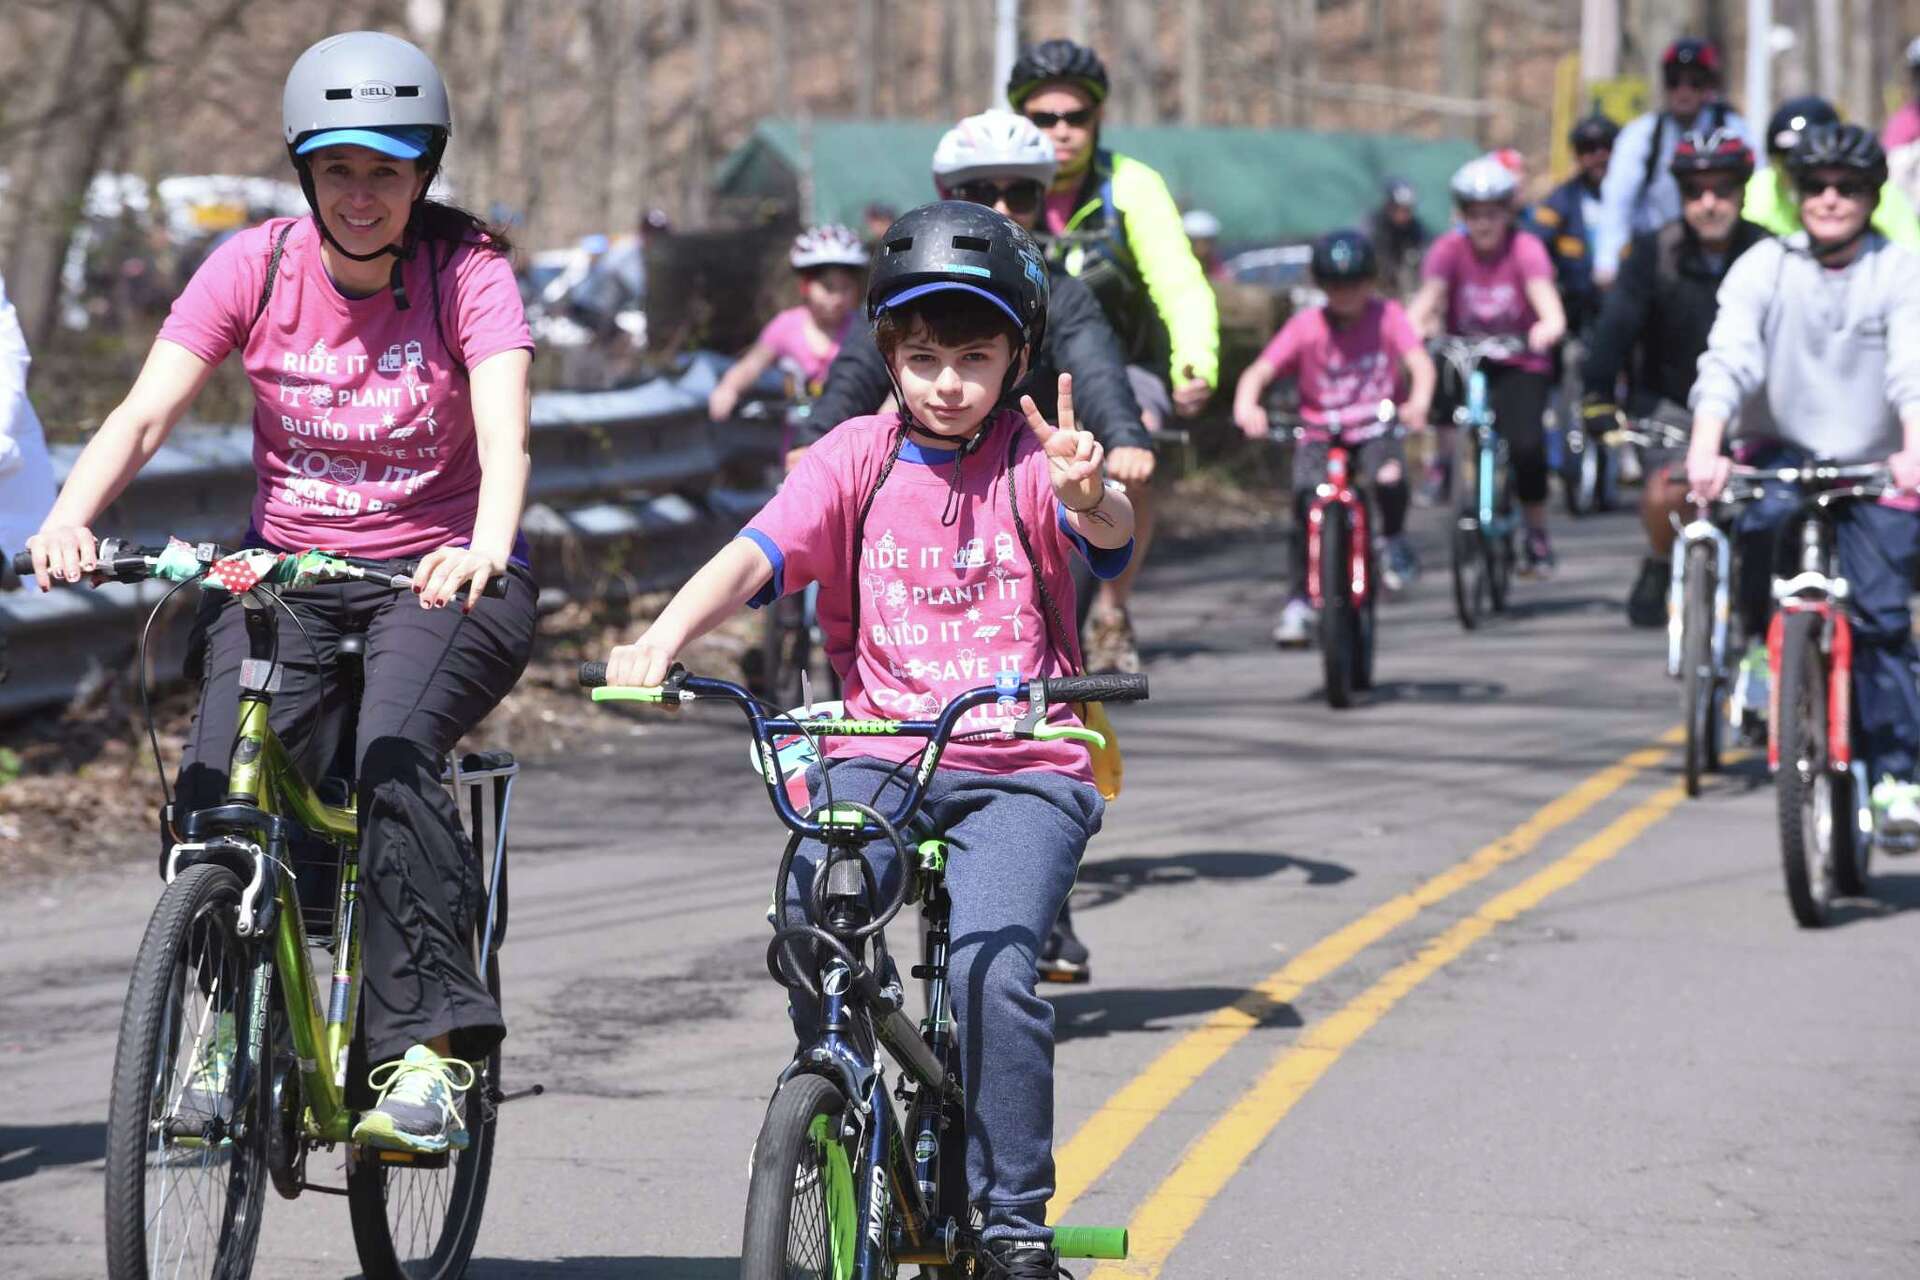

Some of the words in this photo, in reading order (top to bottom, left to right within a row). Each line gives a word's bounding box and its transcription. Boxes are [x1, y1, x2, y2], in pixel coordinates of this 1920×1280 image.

[360, 87, 392, 97] BELL
[283, 352, 338, 375] RIDE
[347, 354, 368, 375] IT
[338, 387, 402, 408] PLANT
[407, 384, 430, 407] IT
[281, 415, 348, 442] BUILD
[359, 423, 379, 441] IT
[417, 446, 438, 460] IT
[336, 487, 362, 516] TO
[920, 547, 944, 568] IT
[912, 581, 987, 606] PLANT
[998, 578, 1020, 600] IT
[872, 623, 929, 646] BUILD
[940, 621, 963, 643] IT
[929, 657, 990, 681] SAVE
[1000, 654, 1023, 672] IT
[917, 741, 937, 786] AVIGO
[868, 1165, 887, 1249] AVIGO
